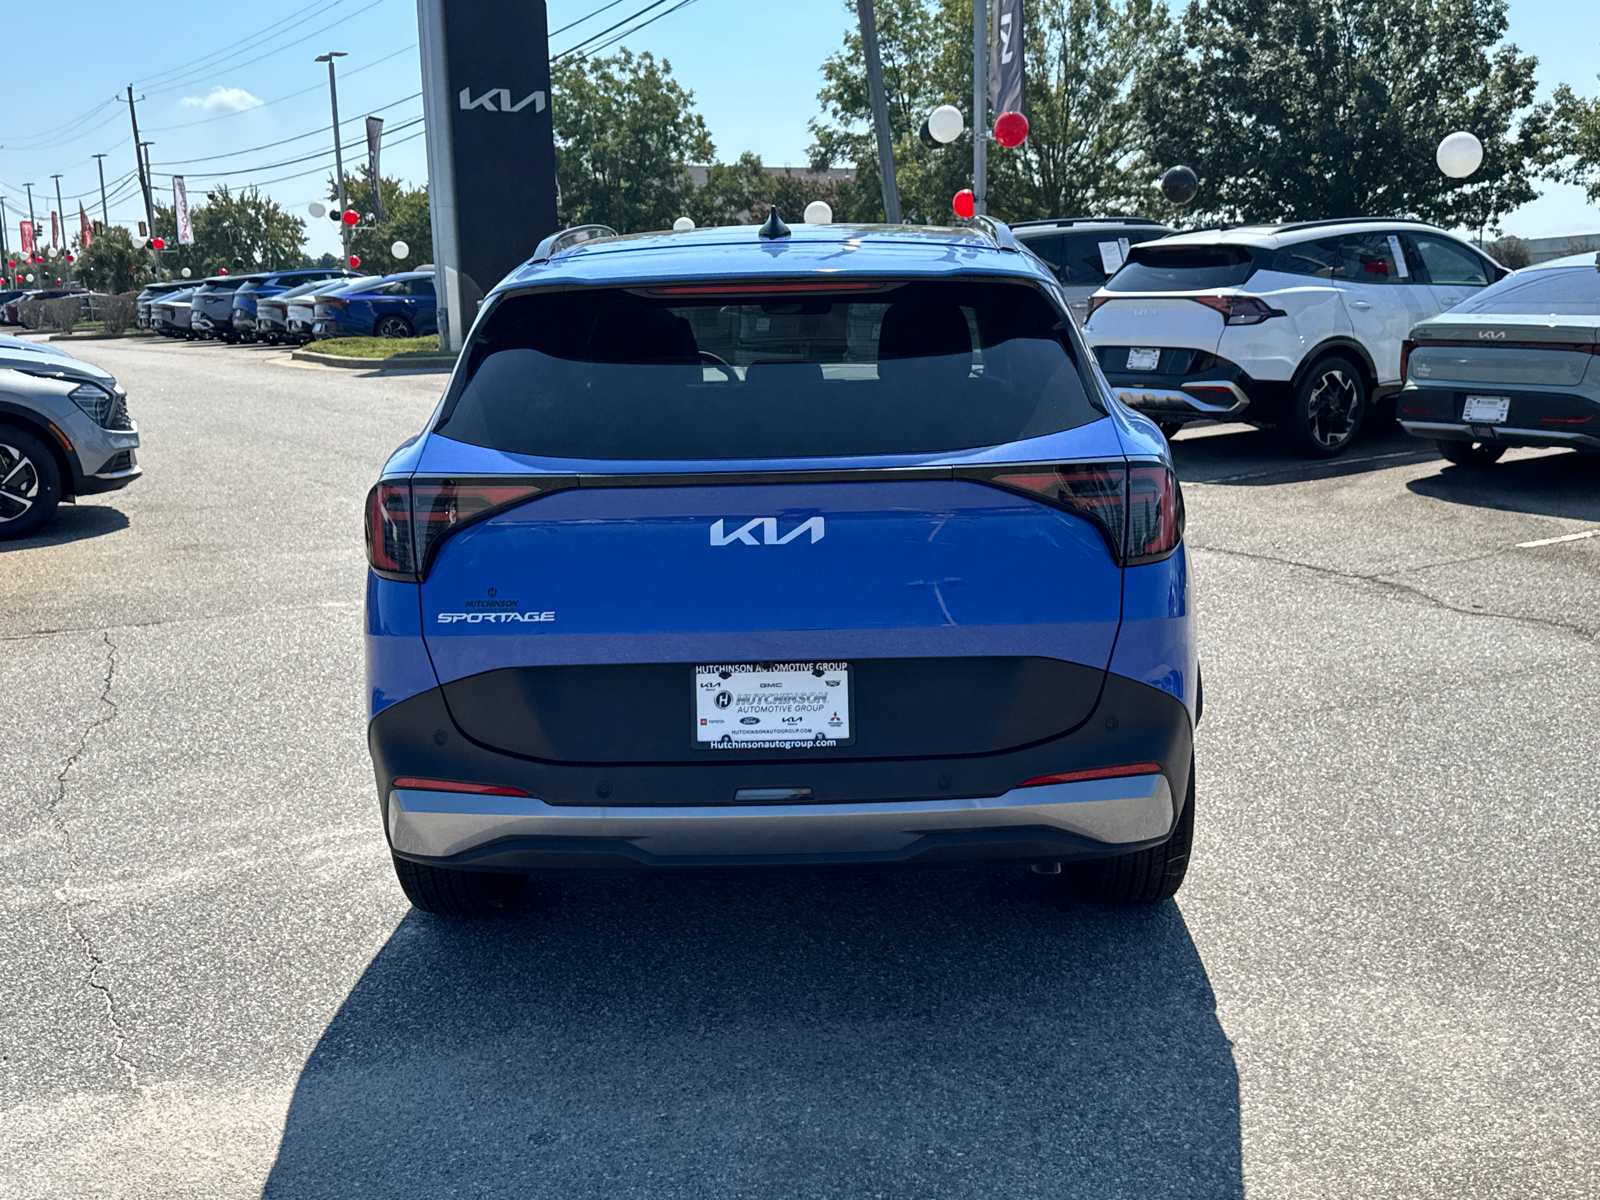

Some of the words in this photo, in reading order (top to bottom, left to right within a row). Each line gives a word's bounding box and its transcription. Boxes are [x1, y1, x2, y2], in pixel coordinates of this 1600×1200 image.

[459, 87, 546, 114] KIA
[1134, 308, 1158, 316] KIA
[1478, 330, 1506, 339] KIA
[709, 516, 825, 546] KIA
[437, 611, 556, 624] SPORTAGE
[695, 664, 753, 674] HUTCHINSON
[816, 662, 848, 671] GROUP
[735, 691, 828, 706] HUTCHINSON
[737, 705, 792, 713] AUTOMOTIVE
[794, 704, 825, 712] GROUP
[782, 716, 803, 724] KIA
[710, 738, 837, 749] Hutchinsonautogroup.com
